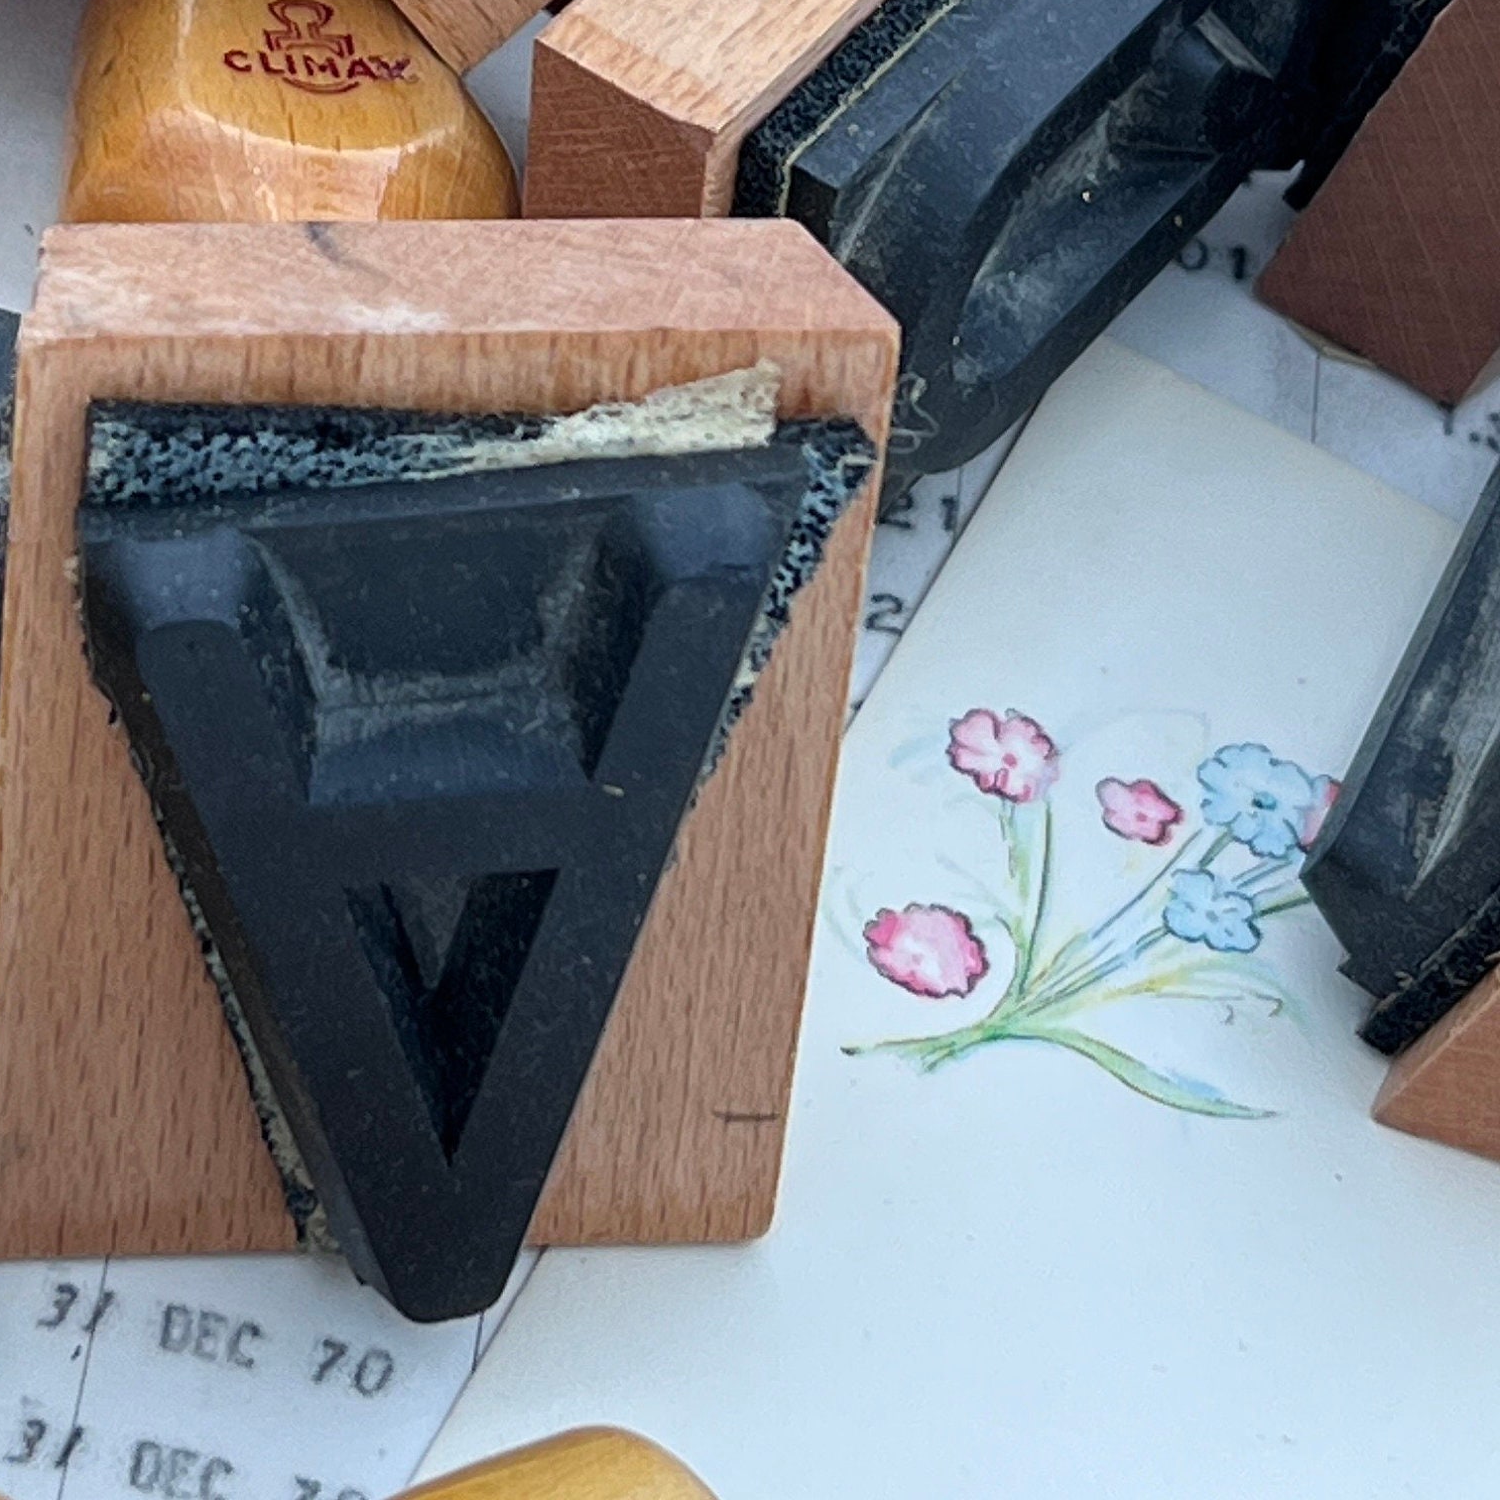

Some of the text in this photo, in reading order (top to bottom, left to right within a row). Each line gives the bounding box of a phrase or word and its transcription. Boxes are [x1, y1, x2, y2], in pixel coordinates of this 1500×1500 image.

[223, 49, 416, 83] CLIMAX
[158, 1302, 266, 1369] DEC
[311, 1336, 397, 1397] 70
[129, 1438, 235, 1500] DEC
